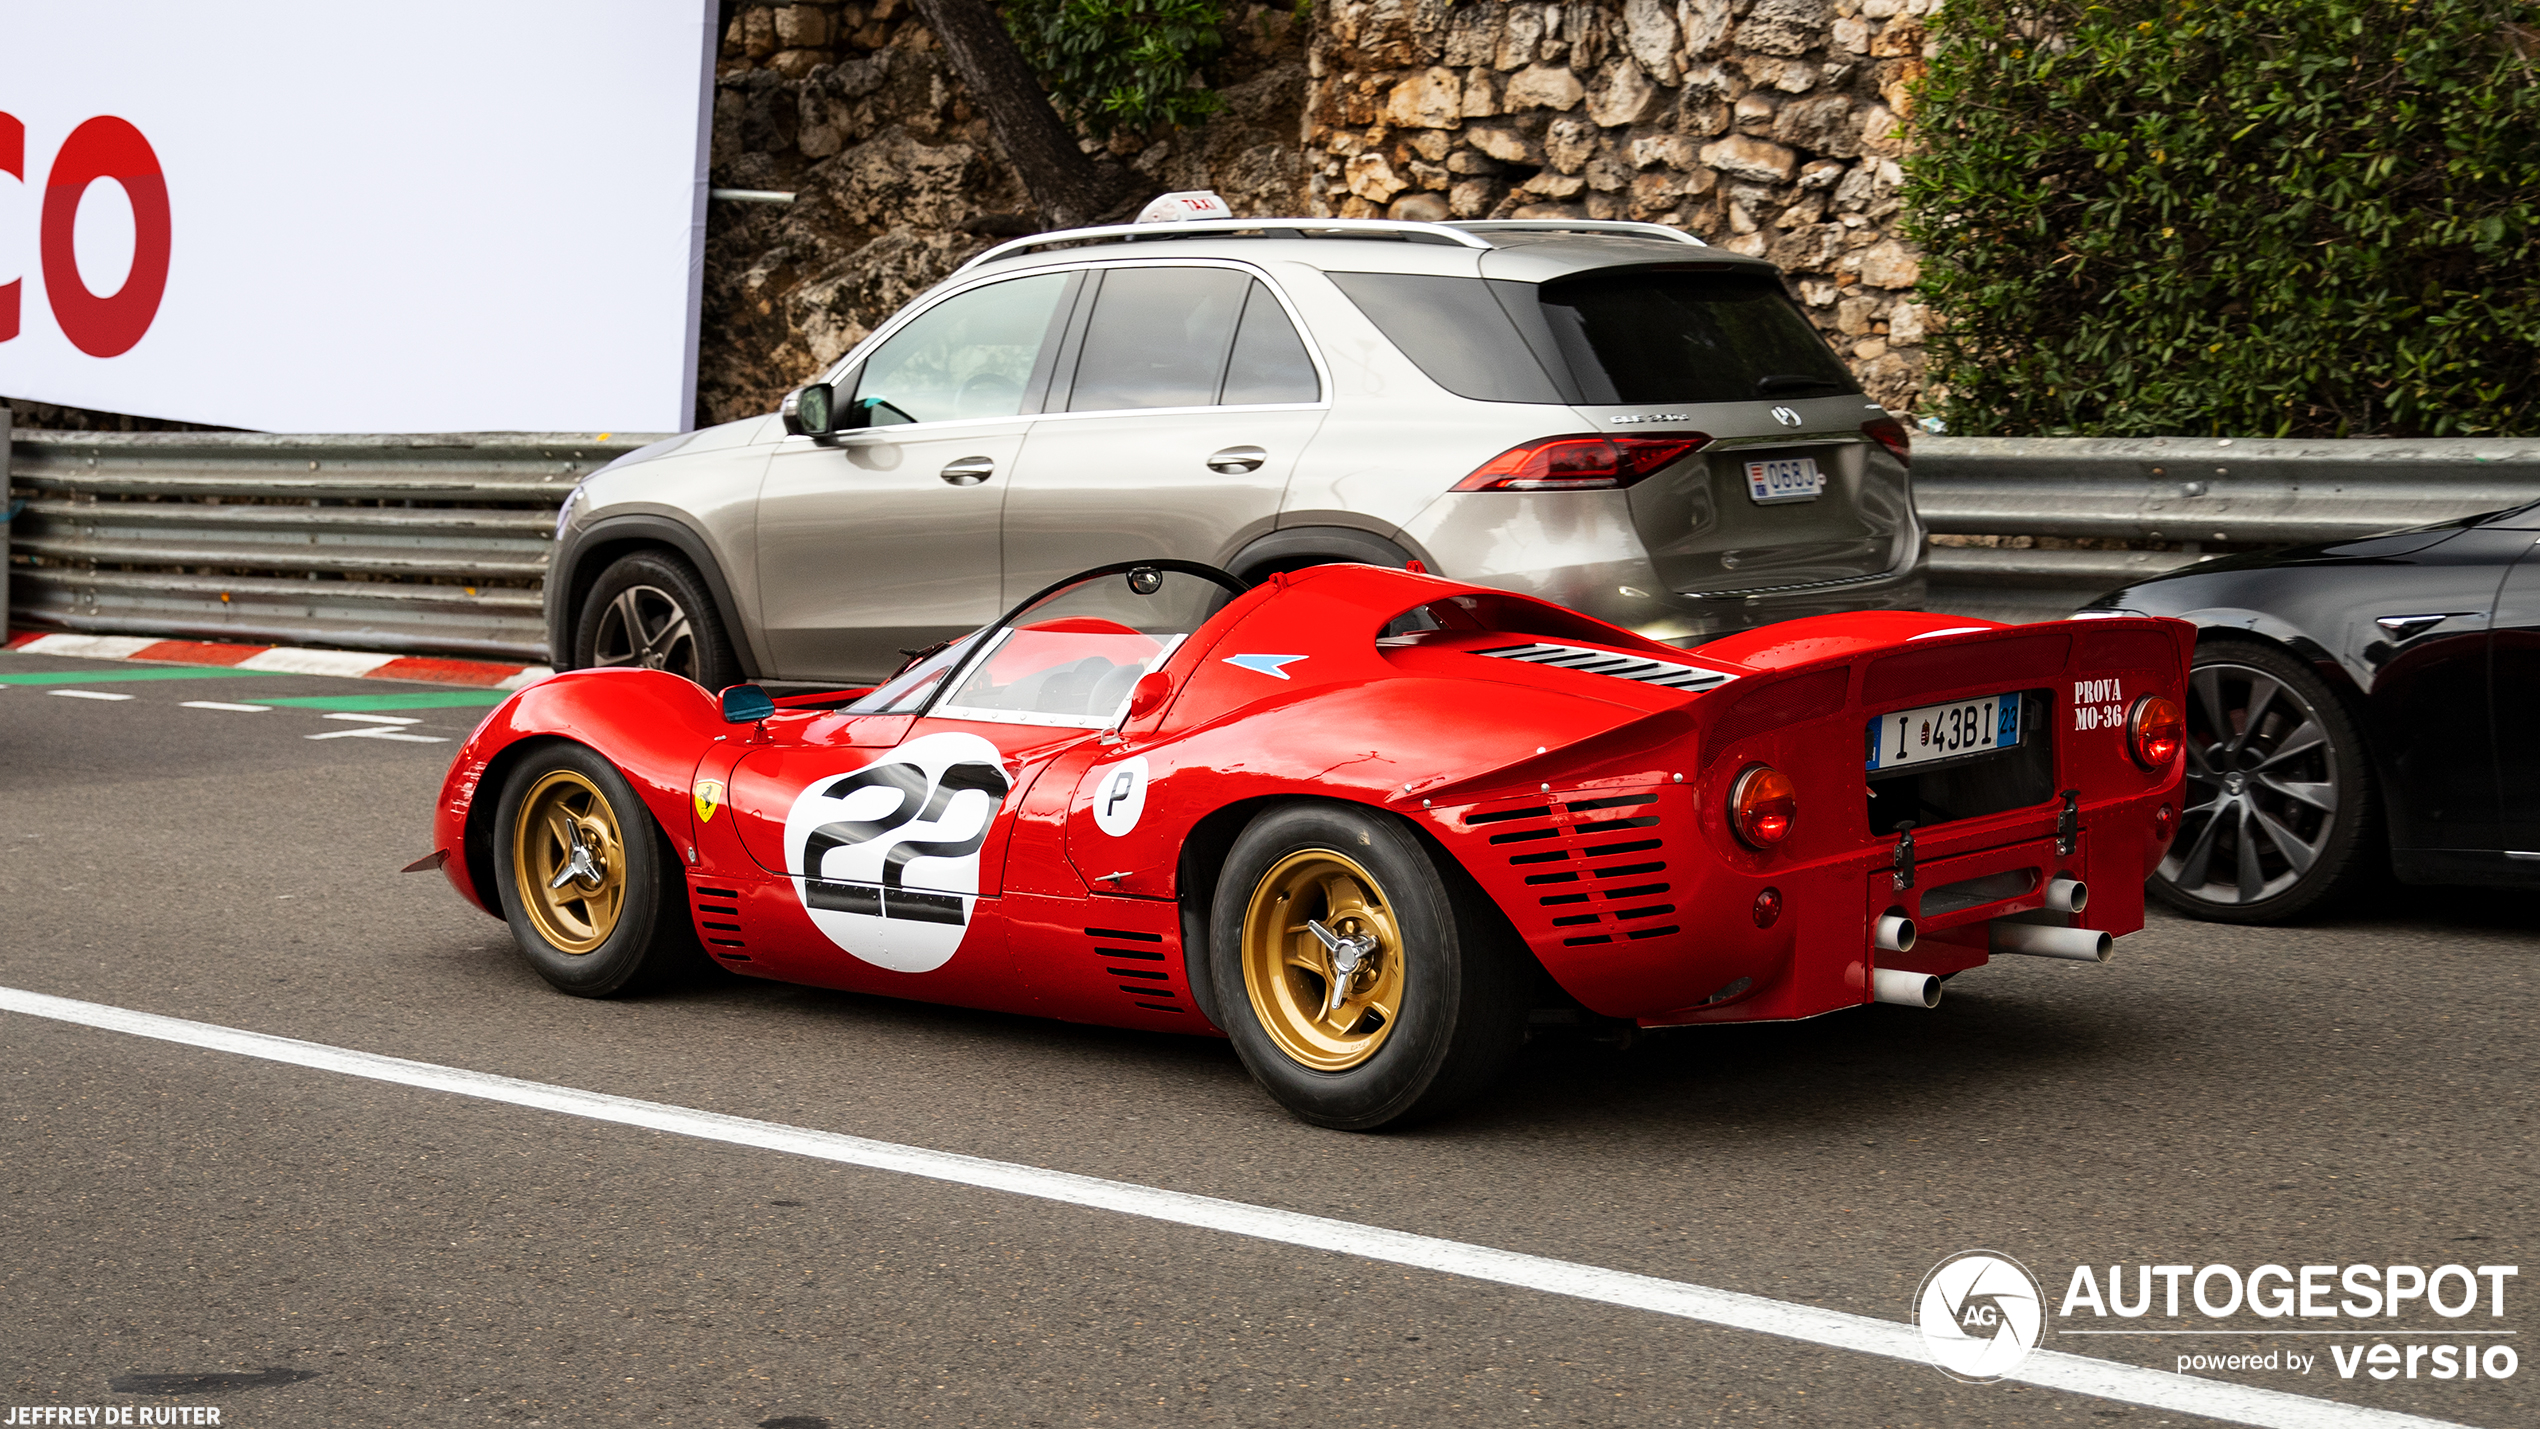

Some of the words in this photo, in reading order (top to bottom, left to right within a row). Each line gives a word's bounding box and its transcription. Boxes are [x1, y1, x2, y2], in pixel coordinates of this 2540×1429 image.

[1181, 198, 1217, 211] TAXI
[1767, 459, 1815, 489] 068J
[2074, 678, 2122, 704] PROVA
[1896, 716, 1908, 760] I
[1932, 702, 1993, 753] 43BI
[1999, 706, 2018, 734] 23
[2074, 704, 2123, 731] MO-36
[1106, 771, 1134, 817] P
[803, 761, 1010, 926] 22
